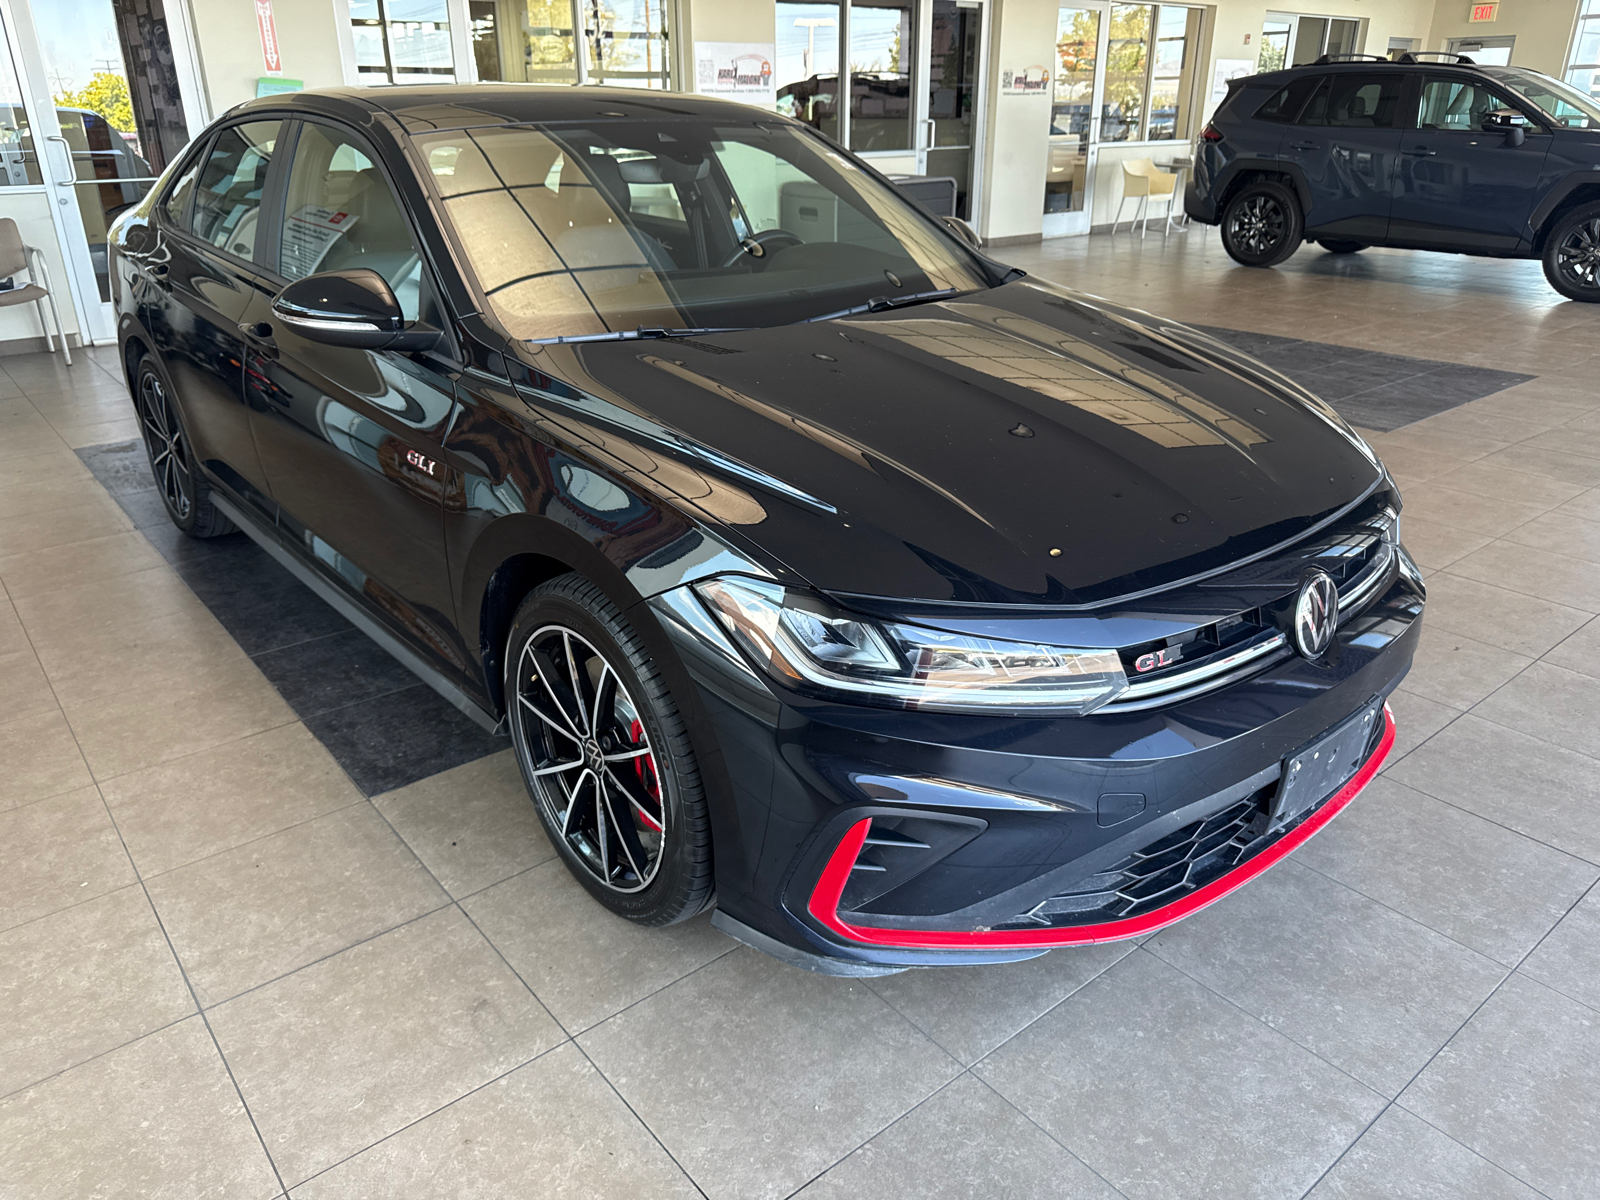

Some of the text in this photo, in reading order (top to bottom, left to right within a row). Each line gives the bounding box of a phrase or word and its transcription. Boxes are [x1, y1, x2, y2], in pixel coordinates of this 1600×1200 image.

[1473, 5, 1493, 20] EXIT
[738, 74, 761, 85] MALONE
[407, 450, 435, 475] GLI
